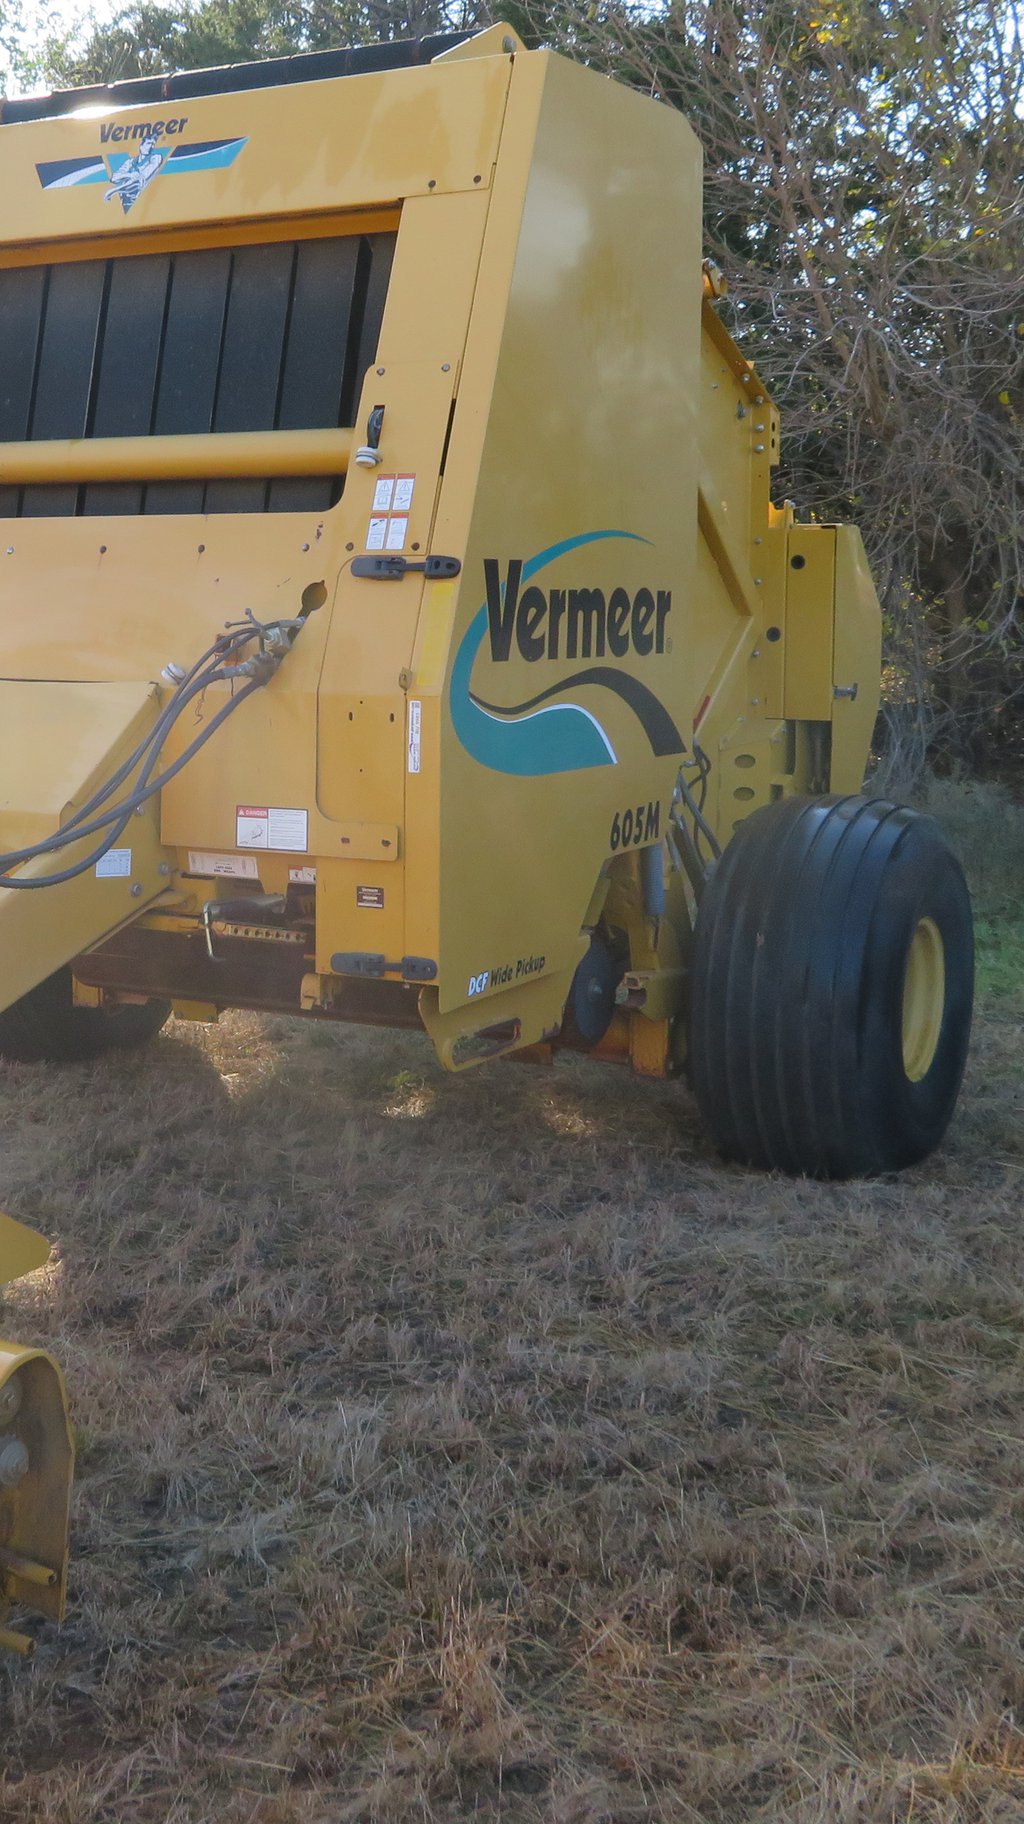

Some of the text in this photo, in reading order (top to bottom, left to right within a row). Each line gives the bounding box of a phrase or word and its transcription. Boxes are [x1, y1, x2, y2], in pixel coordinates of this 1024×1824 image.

[100, 118, 188, 143] Vermeer
[483, 559, 672, 662] Vermeer
[610, 801, 660, 851] 605M
[467, 956, 545, 997] DCF Wide Pickup
